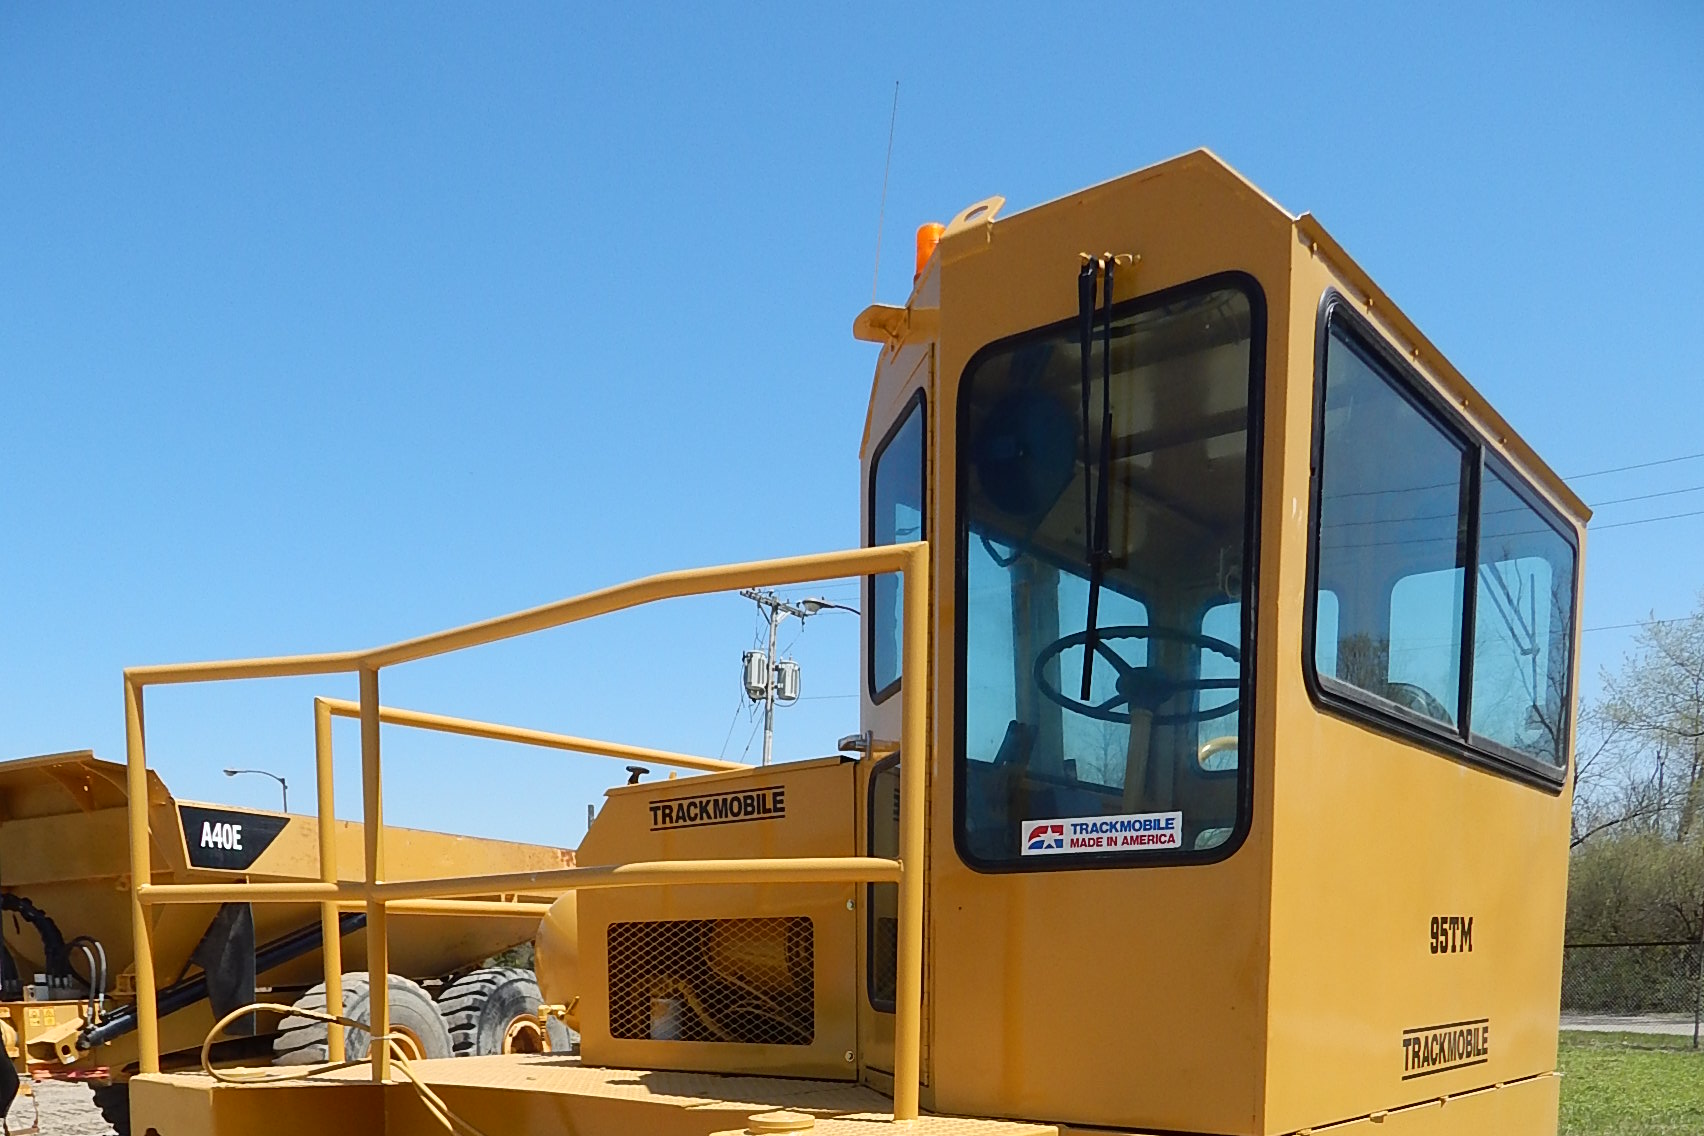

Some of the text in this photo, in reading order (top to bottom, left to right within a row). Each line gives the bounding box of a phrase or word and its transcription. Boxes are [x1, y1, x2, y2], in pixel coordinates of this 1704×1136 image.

[649, 791, 785, 826] TRACKMOBILE
[200, 821, 243, 851] A40E
[1070, 818, 1176, 835] TRACKMOBILE
[1070, 833, 1176, 849] MADE IN AMERICA
[1430, 916, 1473, 954] 95TM
[1402, 1026, 1489, 1071] TRACKMOBILE
